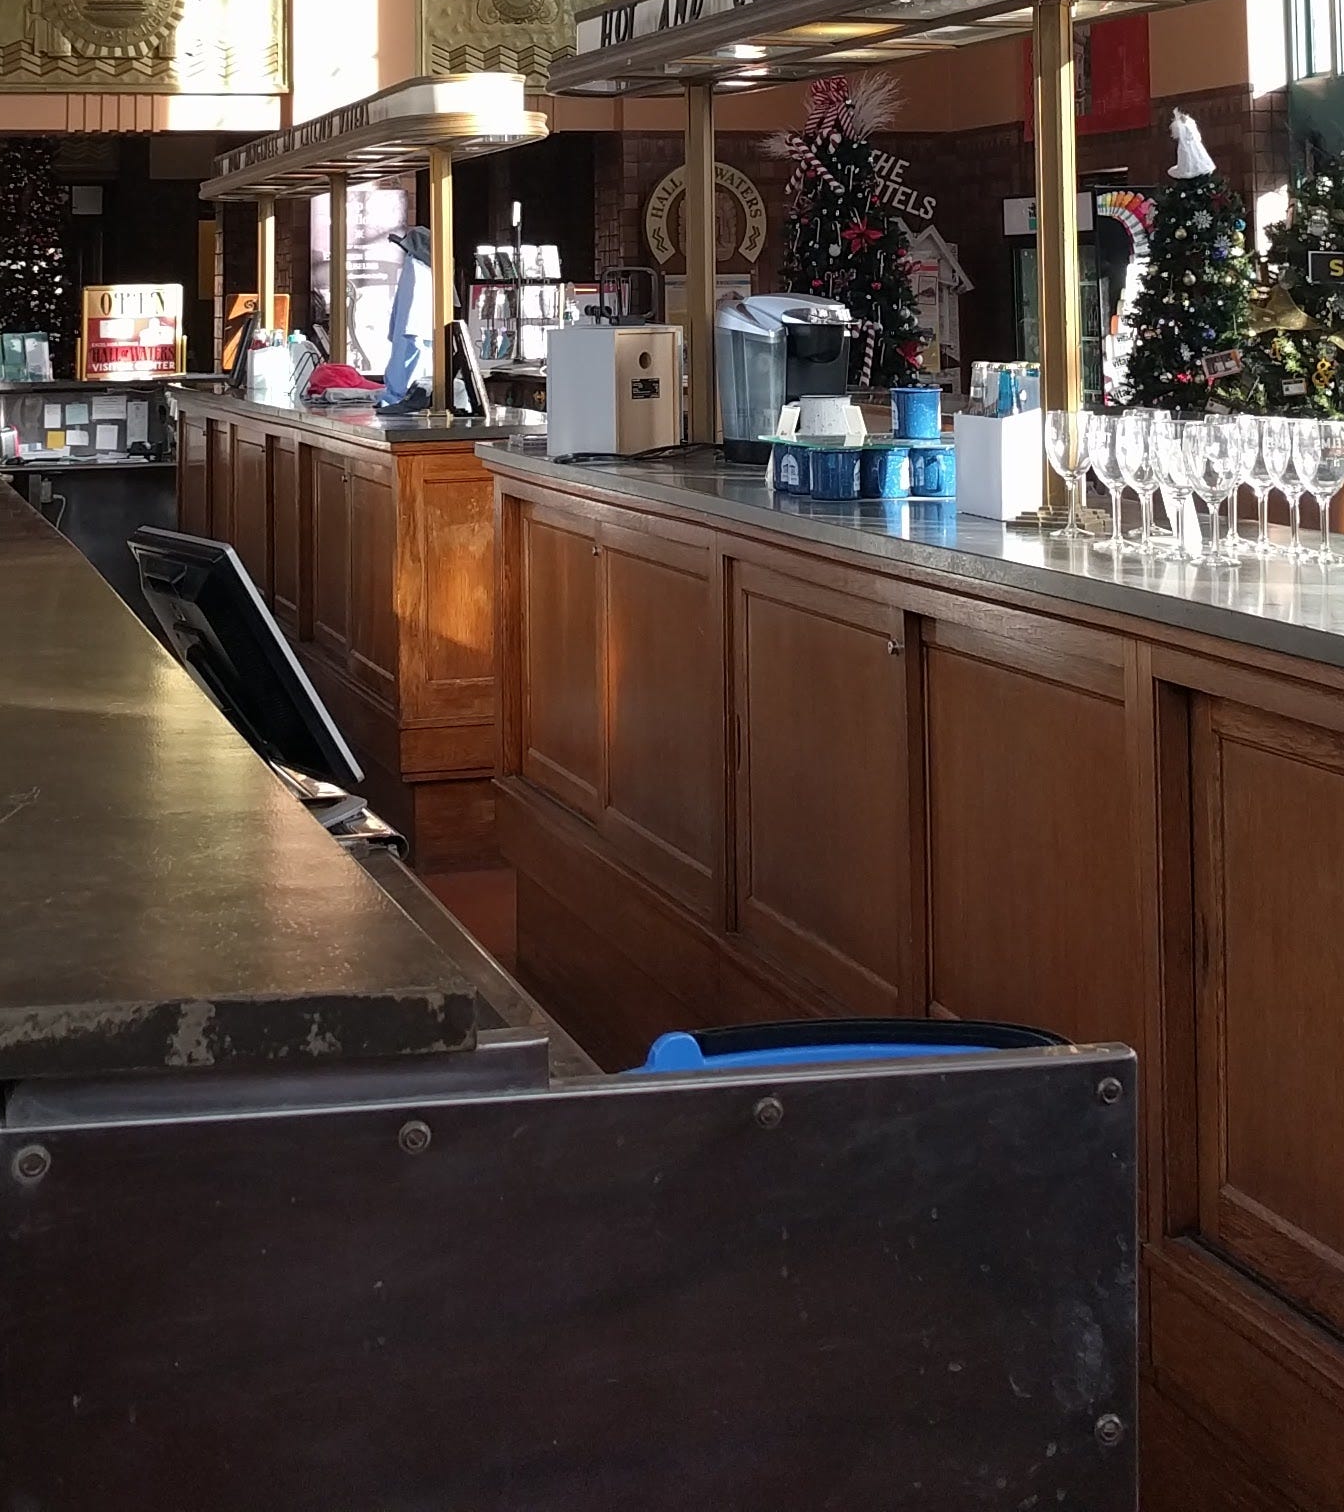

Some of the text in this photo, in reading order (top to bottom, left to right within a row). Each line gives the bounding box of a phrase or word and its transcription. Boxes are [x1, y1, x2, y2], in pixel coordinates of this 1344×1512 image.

[601, 3, 637, 48] HOT
[870, 149, 910, 183] THE
[651, 167, 762, 219] HALL WATERS
[874, 177, 937, 220] OTELS
[92, 361, 133, 373] VISIT
[130, 346, 175, 362] WATERS
